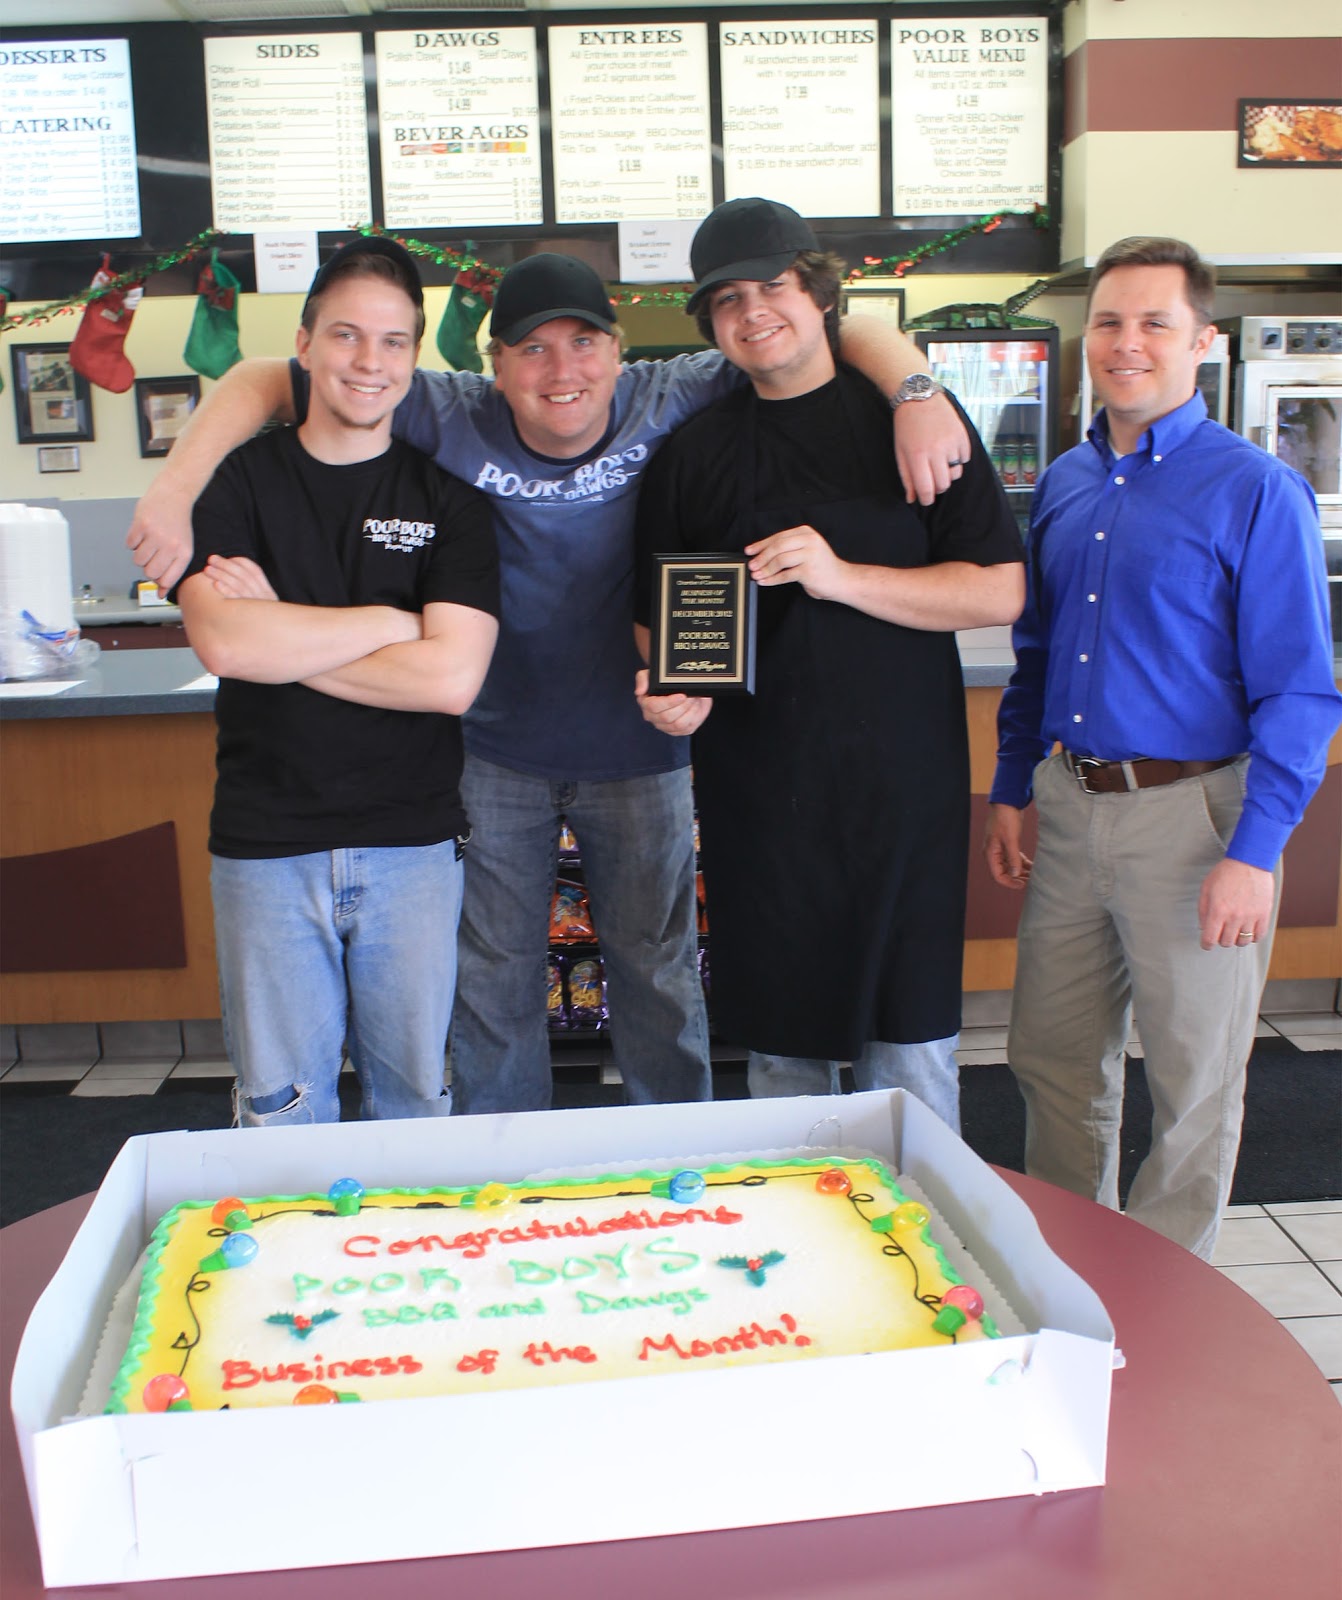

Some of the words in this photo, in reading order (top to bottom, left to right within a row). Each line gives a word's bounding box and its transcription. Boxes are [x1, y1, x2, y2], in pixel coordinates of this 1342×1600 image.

[414, 31, 500, 47] DAWGS
[578, 29, 682, 45] ENTREES
[724, 30, 874, 45] SANDWICHES
[899, 29, 967, 44] POOR
[981, 28, 1040, 43] BOYS
[256, 44, 320, 58] SIDES
[913, 49, 970, 63] VALUE
[979, 48, 1026, 63] MENU
[0, 48, 107, 65] DESSERTS
[756, 55, 808, 64] sandwiches
[828, 54, 858, 63] served
[209, 65, 235, 74] Chips
[608, 62, 637, 70] choice
[611, 73, 651, 83] signature
[785, 69, 825, 79] signature
[211, 78, 240, 88] Dinner
[242, 77, 260, 87] Roll
[212, 94, 235, 102] Fries
[647, 93, 696, 102] Cauliflower
[915, 114, 944, 123] Dinner
[966, 113, 986, 122] BBQ
[989, 113, 1024, 122] Chicken
[0, 116, 111, 134] CATERING
[748, 121, 784, 130] Chicken
[920, 125, 949, 135] Dinner
[394, 125, 528, 142] BEVERAGES
[559, 130, 594, 139] Smoked
[598, 129, 636, 139] Sausage
[670, 128, 705, 137] Chicken
[807, 142, 855, 152] Cauliflower
[245, 149, 280, 157] Cheese
[247, 161, 276, 170] Beans
[795, 158, 835, 167] sandwich
[974, 157, 1007, 166] Cheese
[216, 176, 244, 185] Green
[246, 176, 275, 184] Beans
[975, 184, 1022, 193] Cauliflower
[216, 190, 243, 199] Onion
[218, 202, 240, 211] Fried
[218, 215, 241, 223] Fried
[243, 214, 290, 223] Cauliflower
[564, 468, 629, 501] DAWGS
[362, 518, 401, 534] POOR
[399, 521, 436, 539] BOYS
[672, 610, 713, 618] DECEMBER
[678, 631, 702, 640] POOR
[673, 642, 690, 650] BBQ
[698, 642, 730, 650] DAWGS
[343, 1205, 743, 1259] Congratulations
[292, 1266, 462, 1302] POOR
[508, 1236, 701, 1285] BOYS
[361, 1302, 459, 1328] BBQ
[477, 1297, 548, 1319] and
[575, 1287, 711, 1316] Dawgs
[221, 1353, 423, 1391] Business
[456, 1348, 500, 1375] of
[522, 1341, 598, 1366] the
[638, 1313, 812, 1361] Month!
